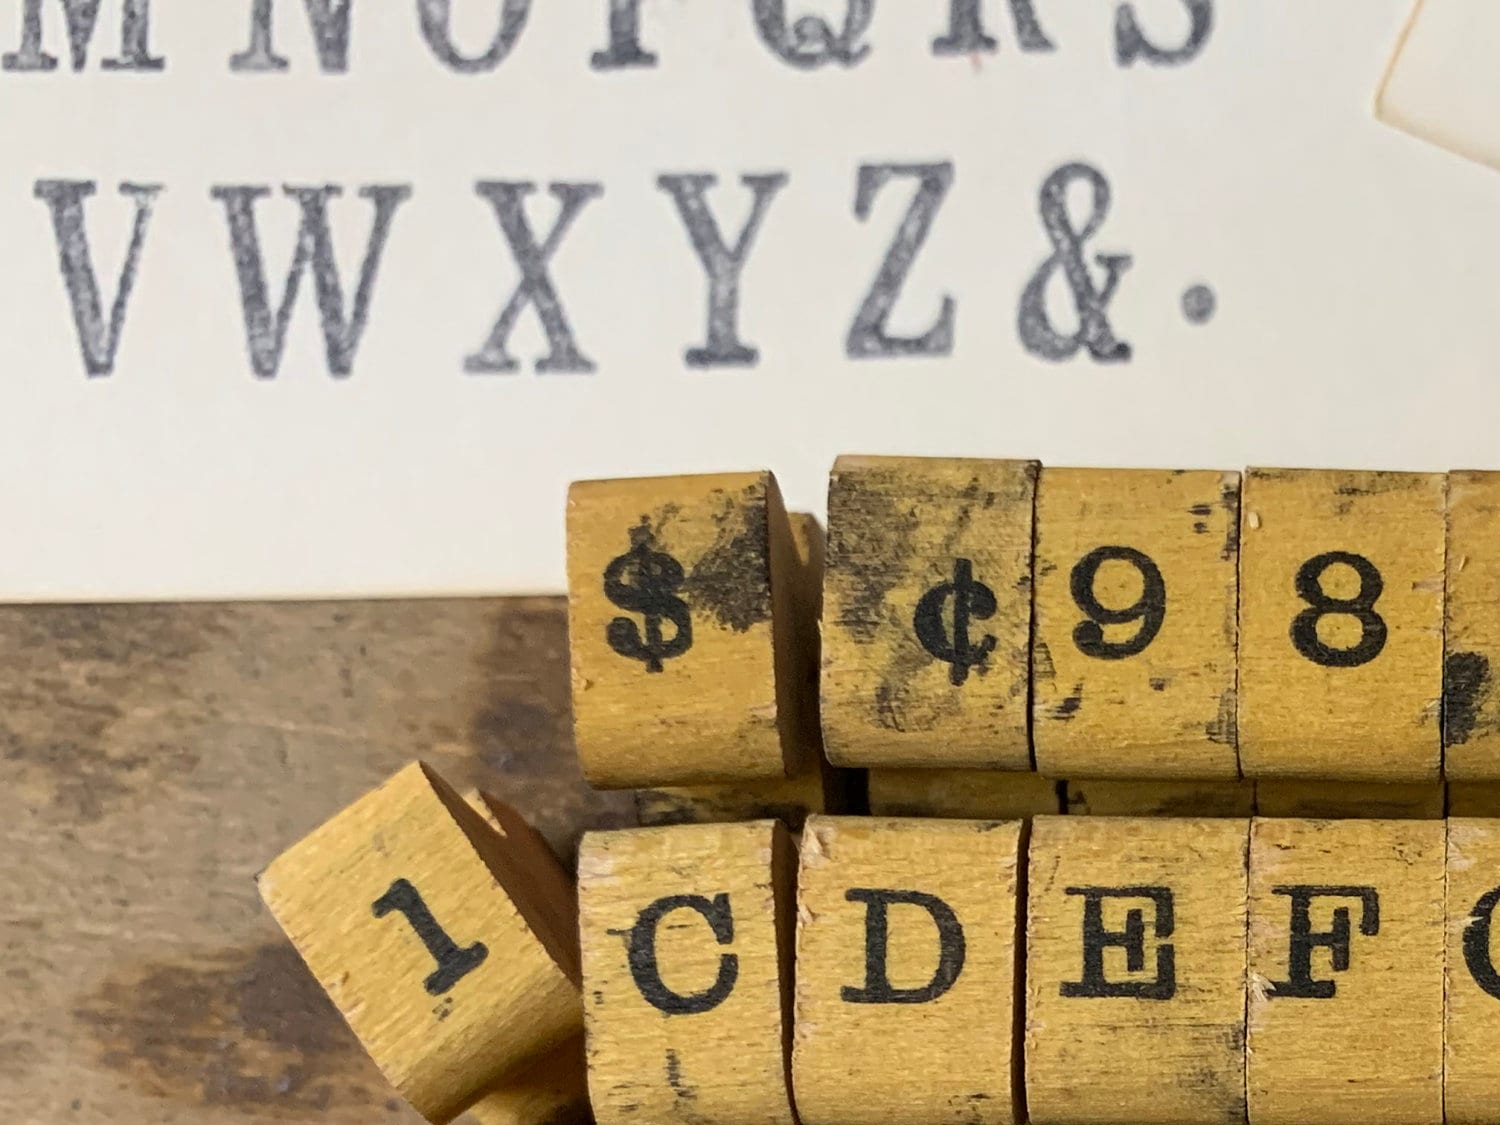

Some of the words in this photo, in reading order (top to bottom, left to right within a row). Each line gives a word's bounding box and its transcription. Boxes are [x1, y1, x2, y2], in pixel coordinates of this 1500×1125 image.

[604, 524, 694, 674] $
[913, 558, 997, 686] ¢
[1069, 545, 1167, 660] 9
[1289, 551, 1388, 668] 8
[370, 877, 488, 996] 1
[625, 891, 738, 1016] C
[840, 888, 968, 1004] D
[1060, 885, 1176, 1000] E
[1267, 884, 1380, 1000] F
